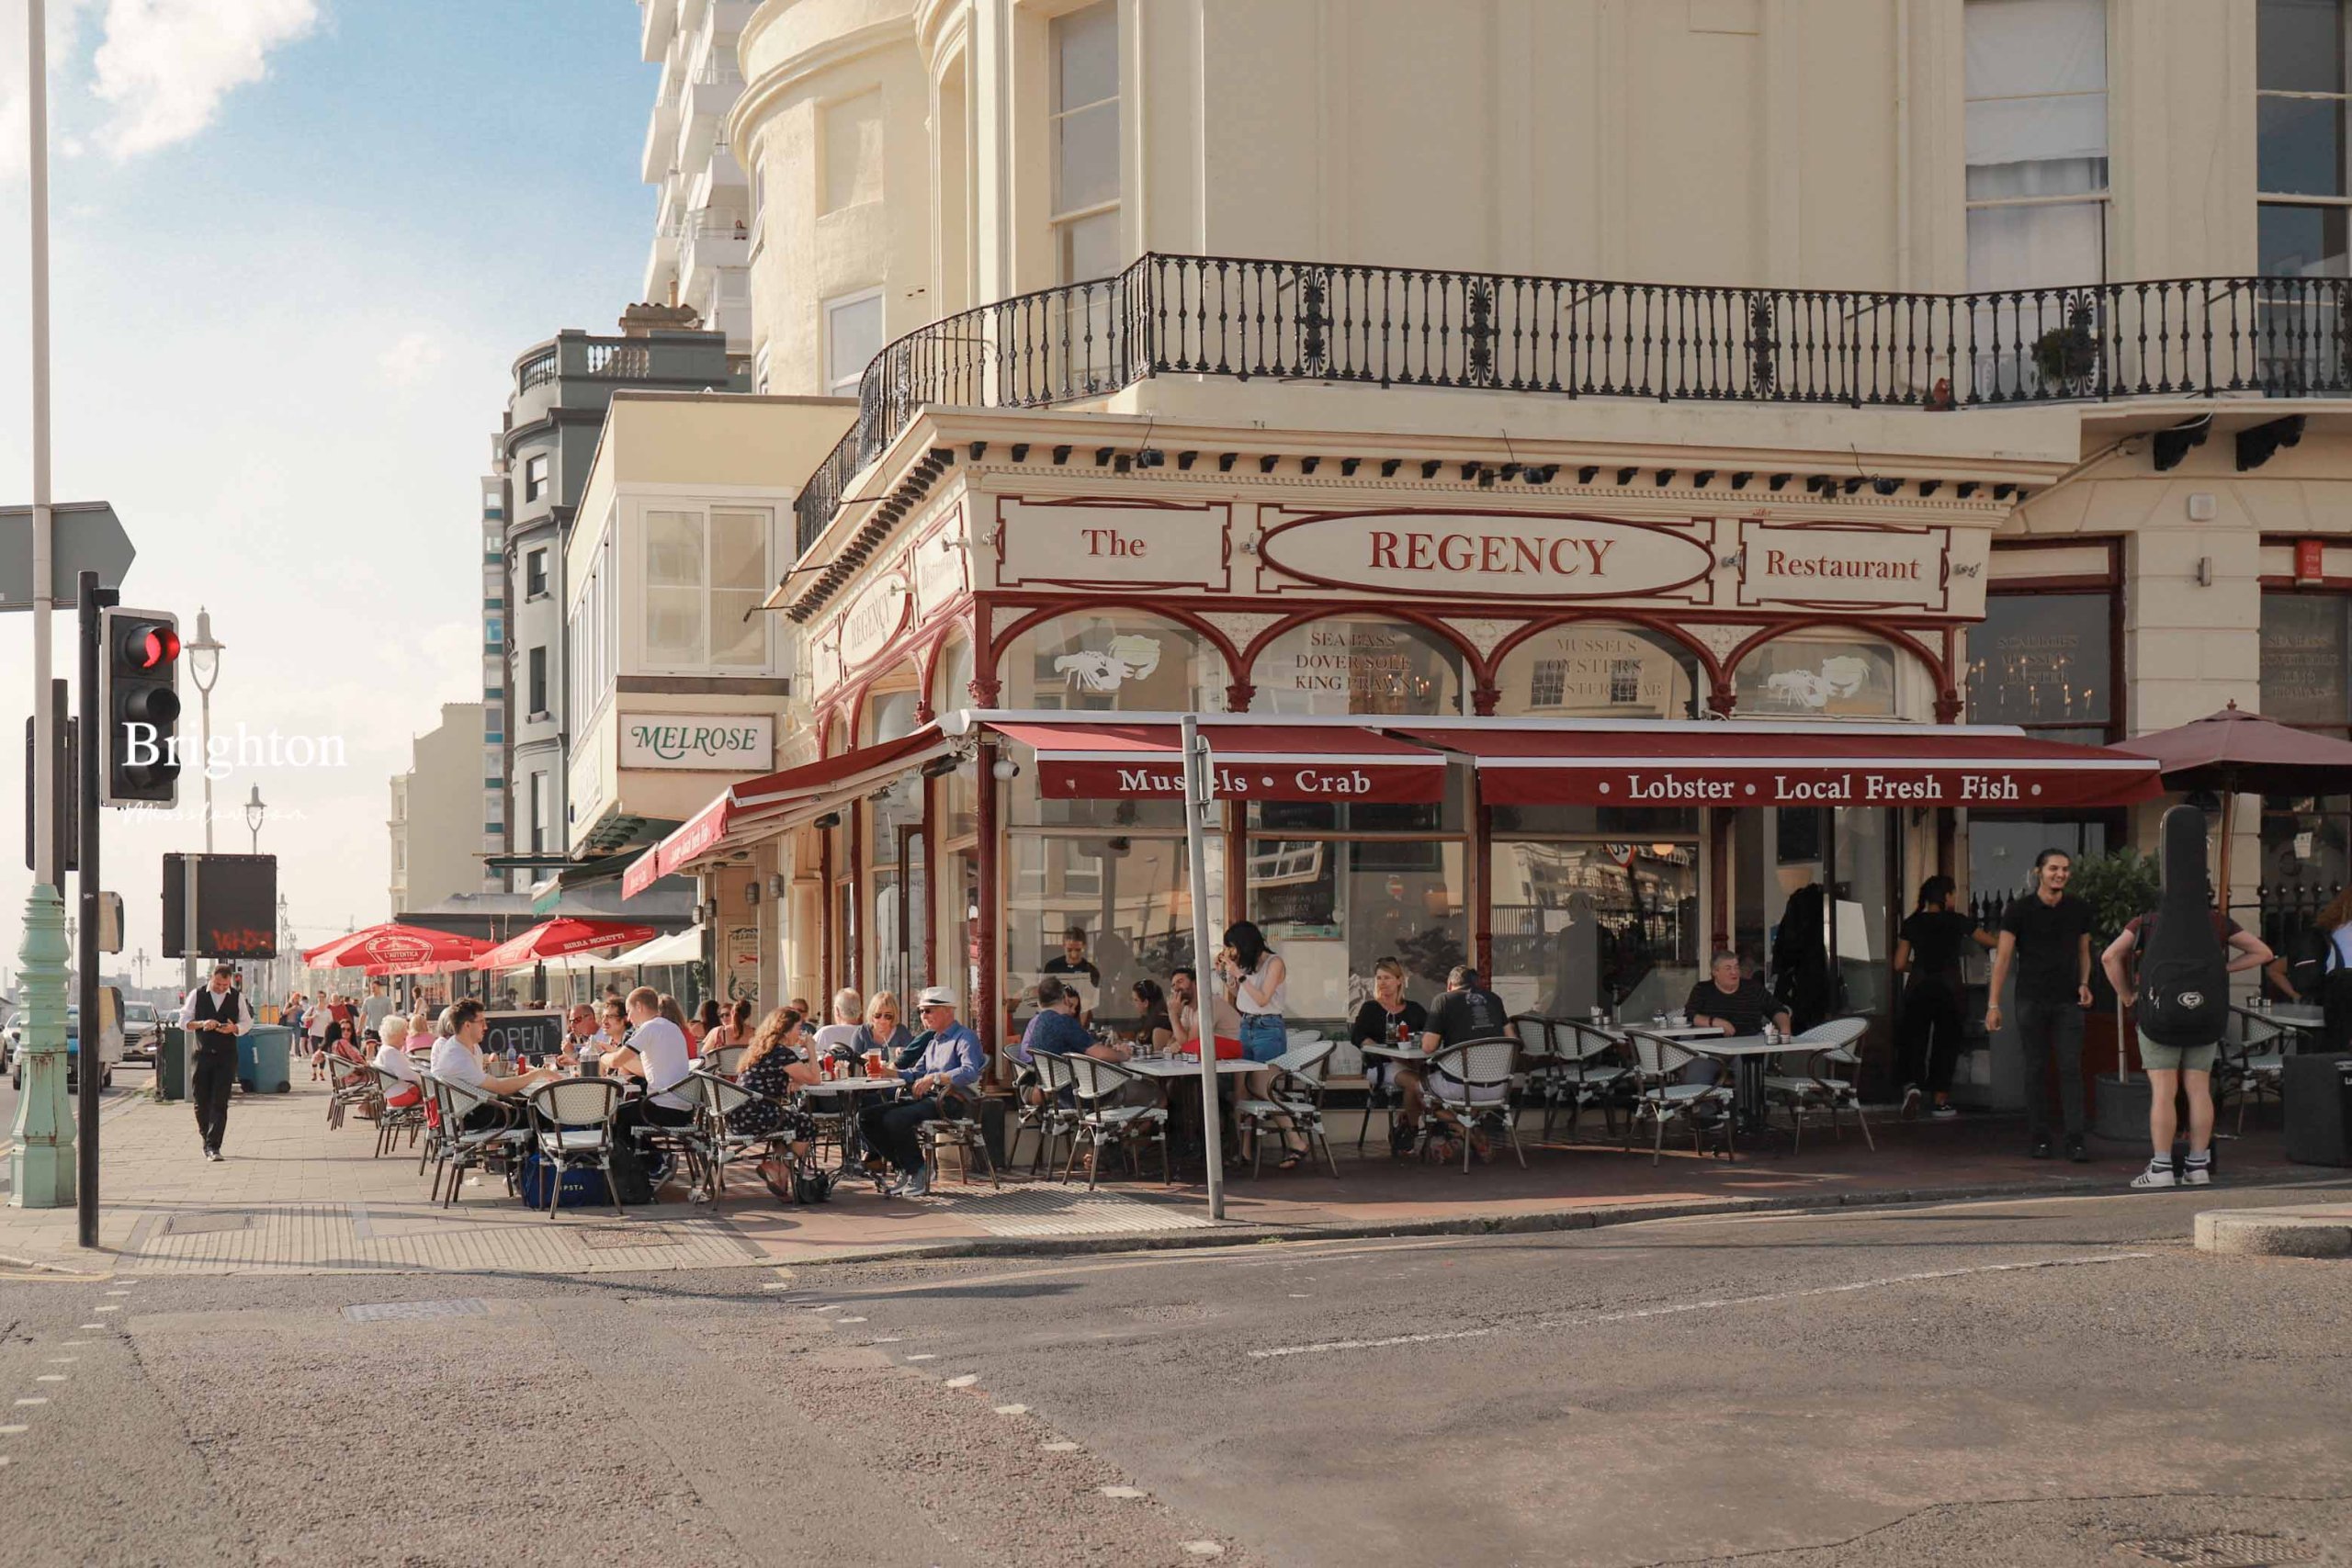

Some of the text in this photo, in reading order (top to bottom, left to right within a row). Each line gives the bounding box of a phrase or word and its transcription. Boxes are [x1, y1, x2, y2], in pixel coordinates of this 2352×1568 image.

[1081, 528, 1146, 558] The
[1368, 530, 1616, 577] REGENCY
[1765, 548, 1922, 581] Restaurant
[850, 591, 892, 650] REGENCY
[1310, 632, 1397, 648] SEA BASS
[1556, 638, 1638, 652] MUSSELS
[1295, 654, 1412, 671] DOVER SOLE
[1546, 659, 1644, 674] OYSTERS
[1295, 675, 1341, 690] KING
[630, 726, 759, 760] MELROSE
[1117, 769, 1371, 794] Musels Crab
[1628, 774, 2019, 799] Lobster Local Fresh Fish
[563, 933, 625, 950] BIRRA MORETTI
[488, 1025, 545, 1053] OPEN
